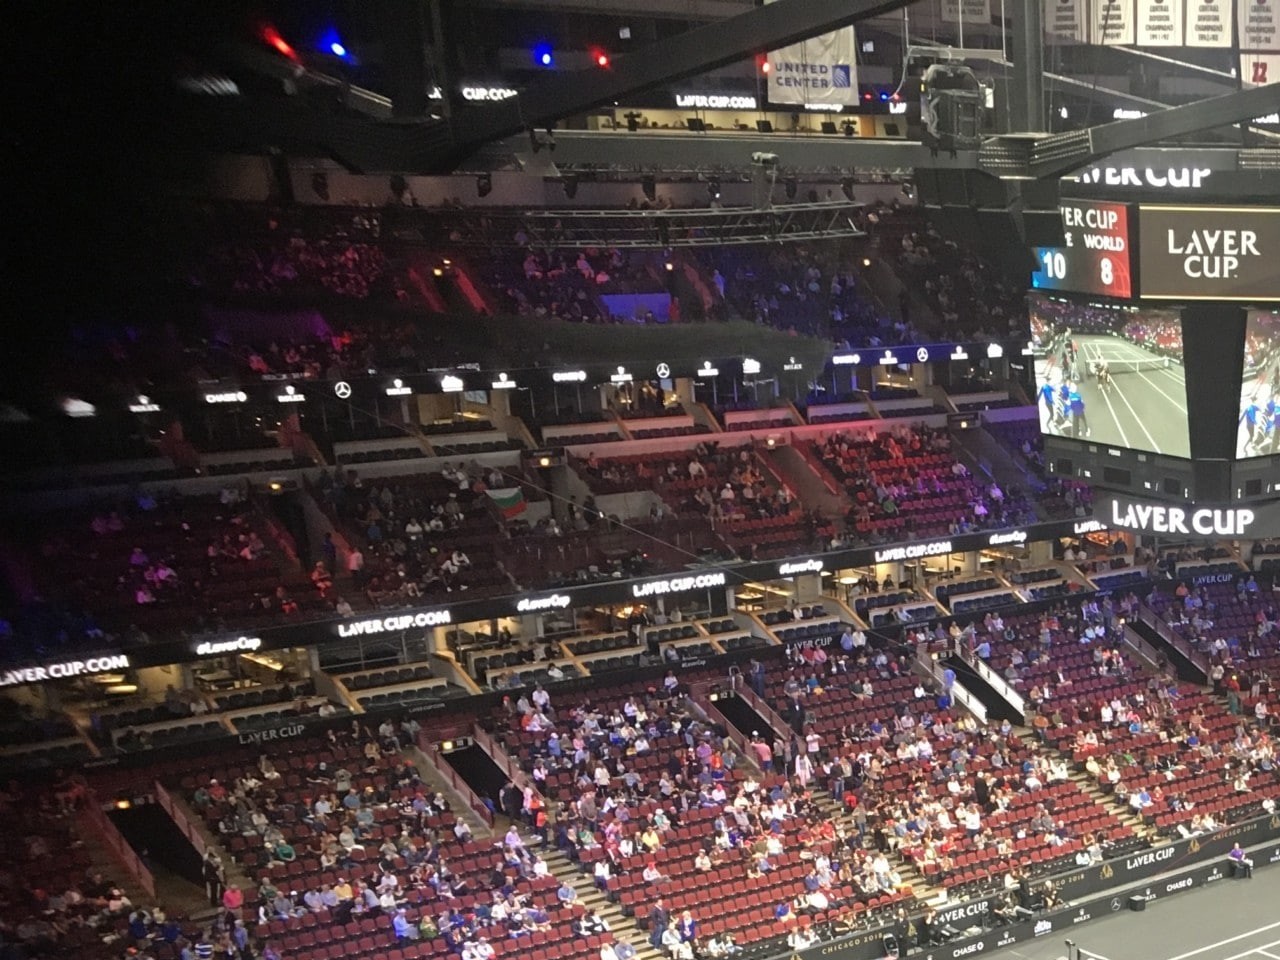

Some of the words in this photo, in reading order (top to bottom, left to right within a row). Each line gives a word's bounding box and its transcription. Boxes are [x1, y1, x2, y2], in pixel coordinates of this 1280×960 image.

[775, 63, 829, 75] UNITED
[776, 76, 829, 88] CENTER
[709, 96, 756, 109] CUP.COM
[1145, 168, 1211, 188] CUP
[1083, 233, 1125, 251] WORLD
[1167, 228, 1261, 256] LAVER
[1043, 252, 1066, 280] 10
[1100, 257, 1114, 286] 8
[1112, 501, 1189, 534] LAVER
[1192, 509, 1254, 535] CUP
[875, 546, 906, 562] LAVER
[906, 541, 952, 558] CUP.COM
[633, 582, 670, 597] LAVER
[670, 573, 725, 593] CUP.COM
[1192, 576, 1216, 585] LAVER
[1216, 573, 1233, 583] CUP
[338, 618, 385, 638] LAVER
[385, 611, 451, 632] CUP.COM
[815, 636, 833, 647] CUP
[48, 654, 130, 678] CUP.COM
[239, 730, 279, 745] LAVER
[279, 724, 306, 738] CUP
[1212, 828, 1242, 841] CHICAGO
[1127, 853, 1155, 870] LAVER
[1155, 846, 1176, 861] CUP
[1067, 873, 1085, 884] 2018
[1166, 880, 1187, 892] CHASE
[966, 902, 989, 916] CUP
[821, 938, 861, 955] CHICAGO
[863, 932, 883, 943] 2018
[953, 943, 977, 958] CHASE
[997, 936, 1016, 947] ROLEX
